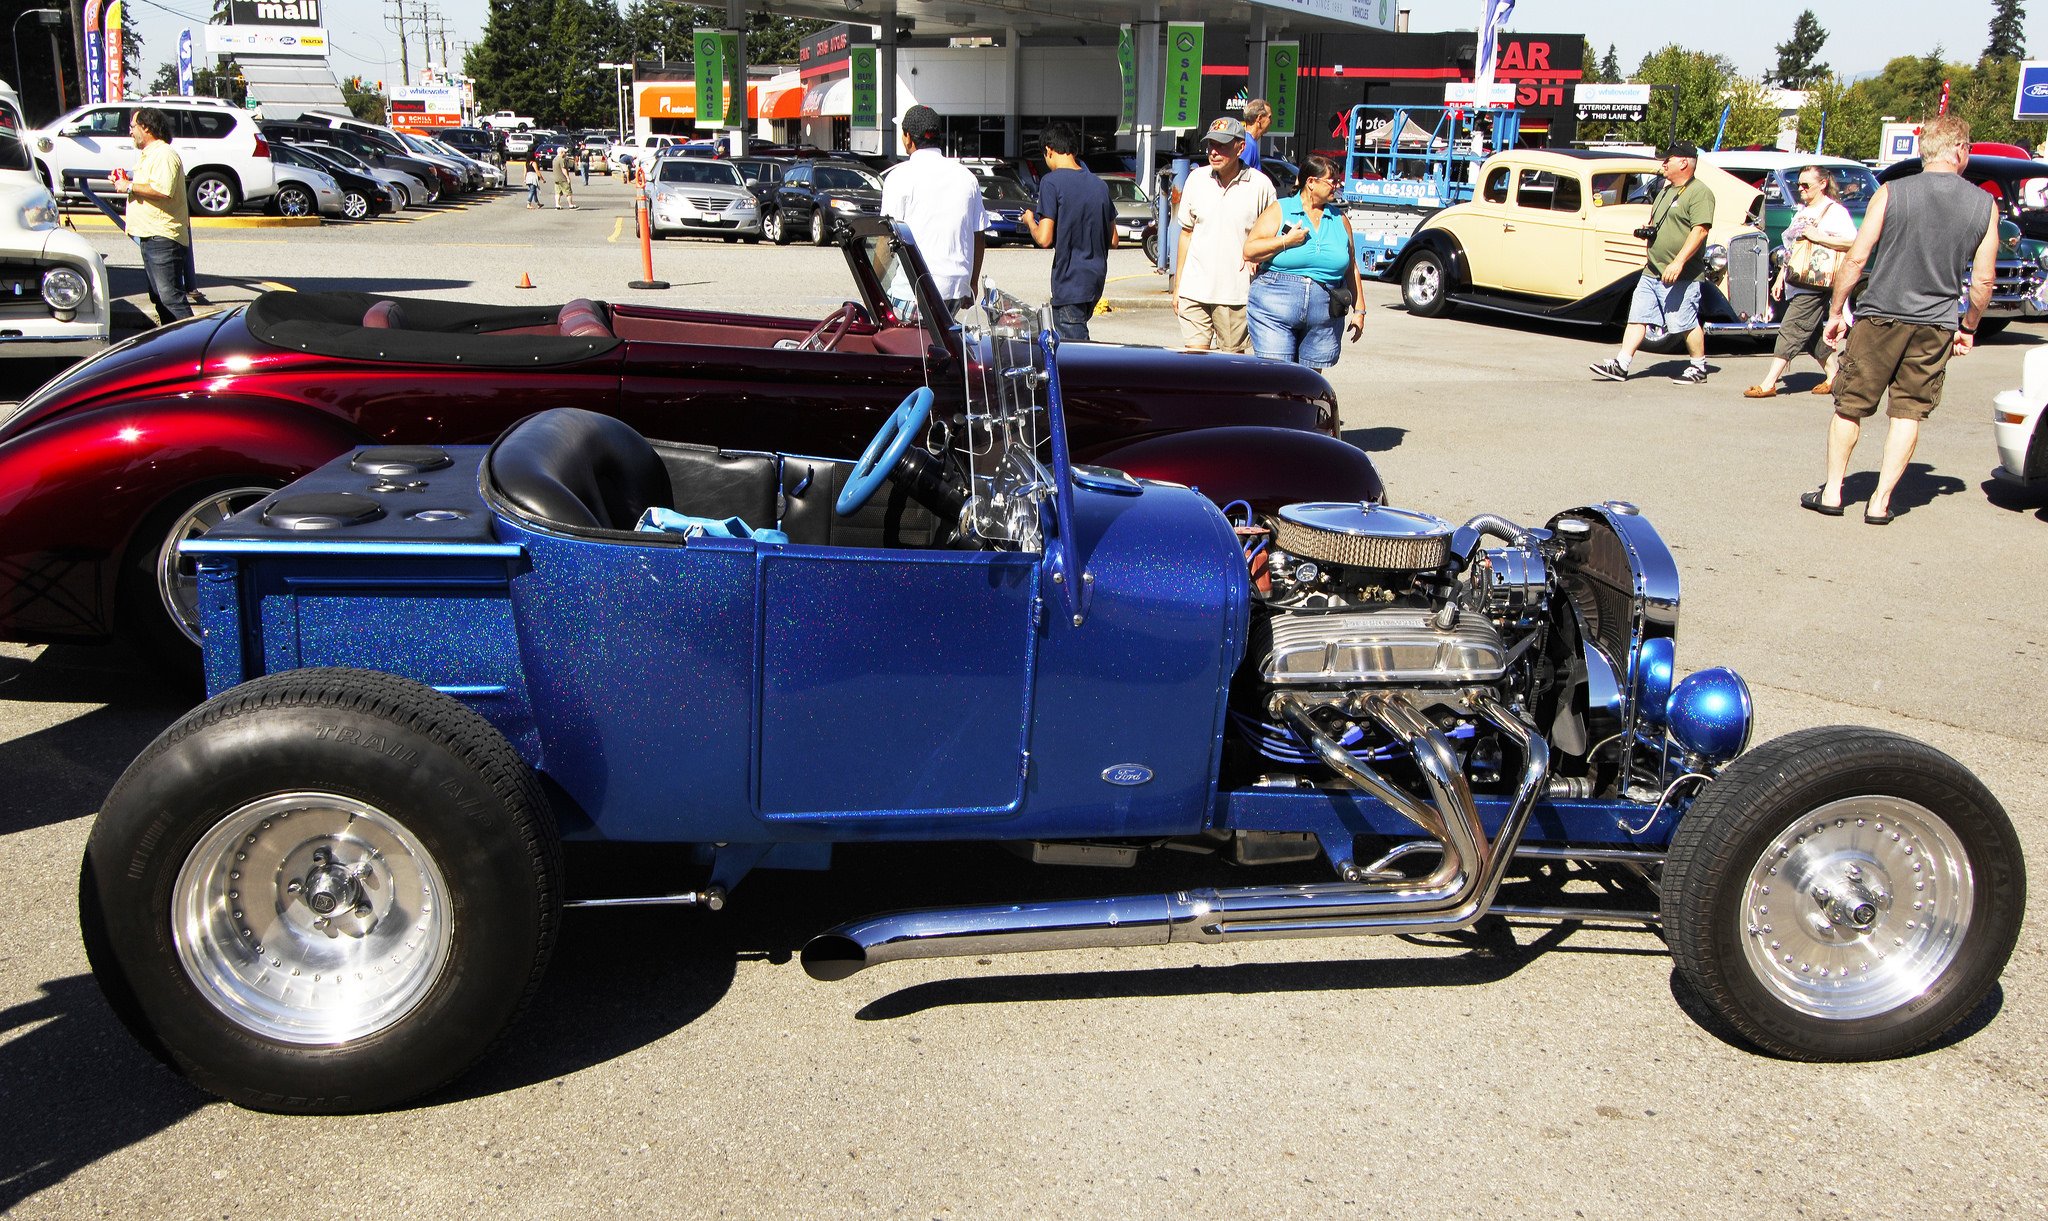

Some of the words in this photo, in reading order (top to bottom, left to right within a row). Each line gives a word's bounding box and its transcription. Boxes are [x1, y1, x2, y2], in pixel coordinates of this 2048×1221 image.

[257, 0, 317, 20] mall
[1352, 5, 1369, 20] VEHICLES
[108, 32, 120, 103] SPECI
[857, 72, 873, 80] BUY
[409, 87, 449, 95] whitewater
[705, 60, 714, 118] FINANCE
[854, 83, 874, 91] HERE
[1177, 58, 1190, 121] SALES
[1598, 88, 1641, 97] whitewater
[1276, 72, 1287, 128] LEASE
[858, 103, 872, 112] PAY
[854, 114, 874, 122] HERE
[1896, 139, 1910, 149] GM
[1355, 182, 1380, 194] Genie
[1382, 183, 1426, 197] GS-1930
[315, 722, 422, 769] TRAIL
[1114, 769, 1142, 781] Ford
